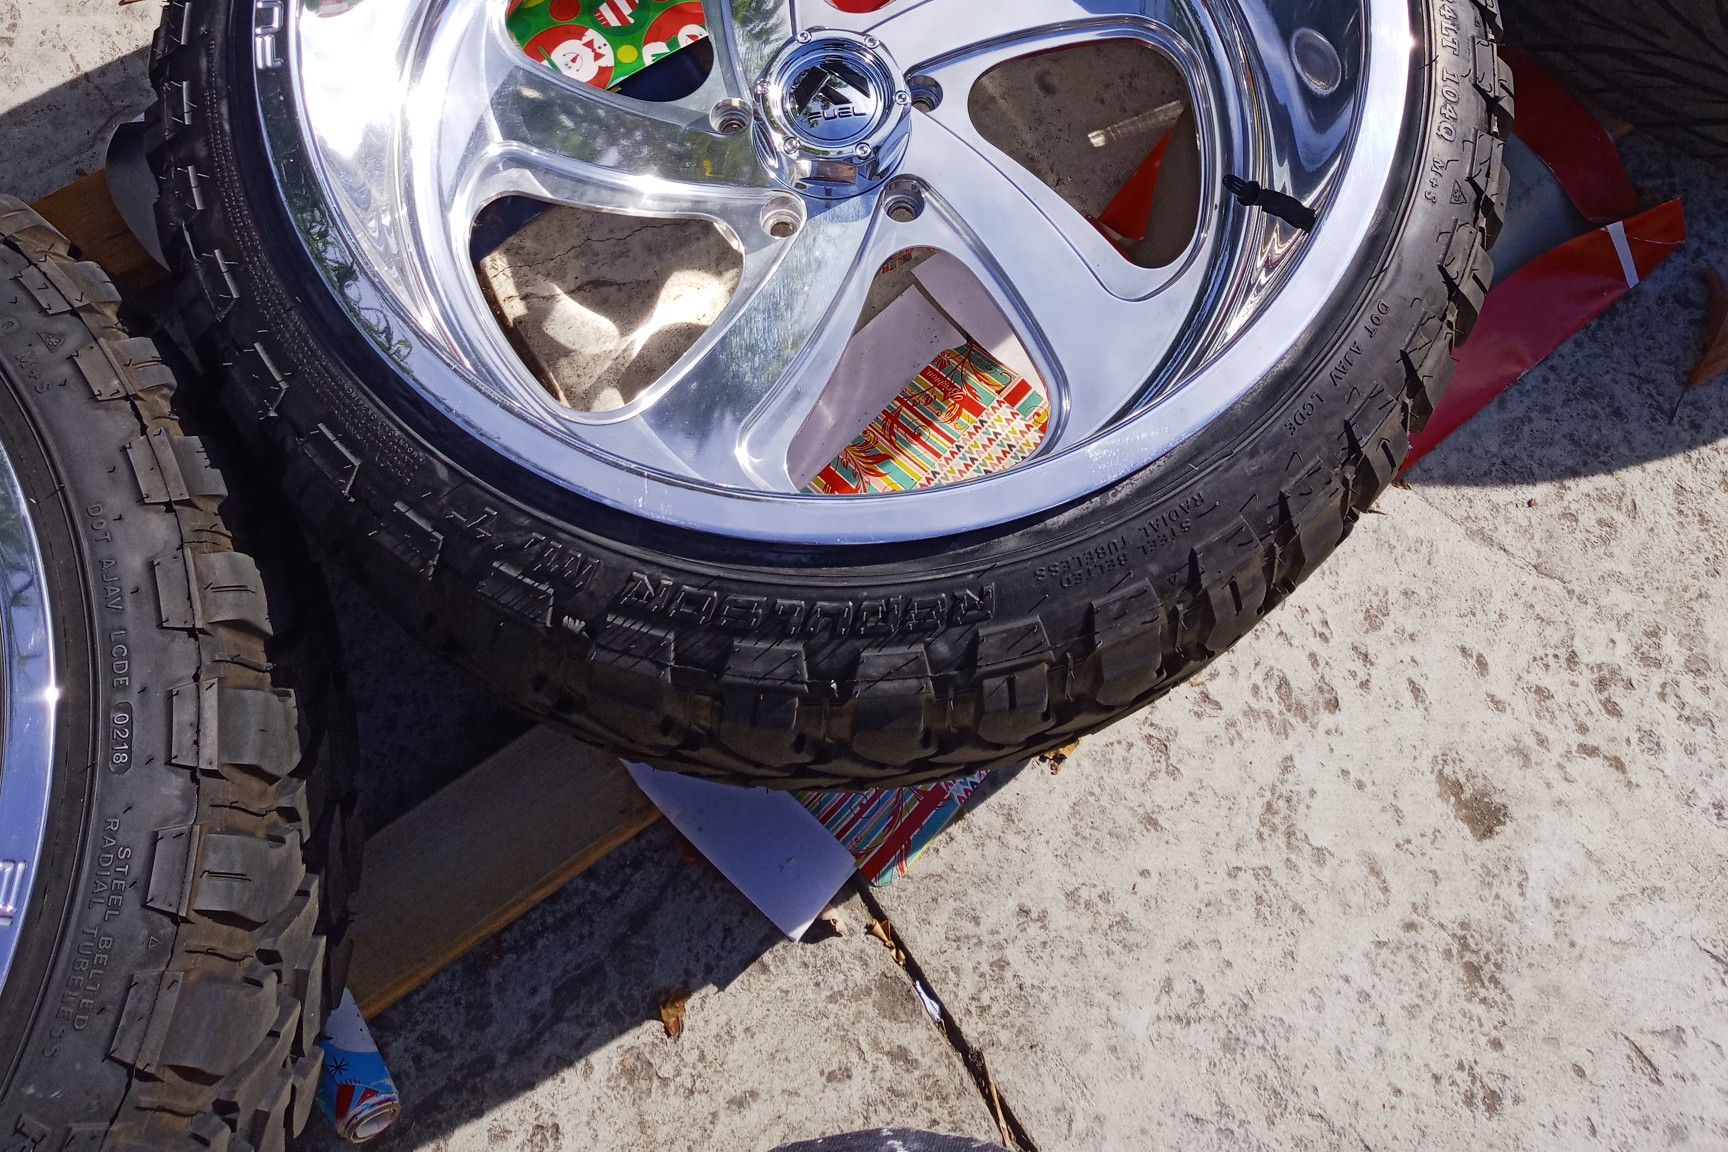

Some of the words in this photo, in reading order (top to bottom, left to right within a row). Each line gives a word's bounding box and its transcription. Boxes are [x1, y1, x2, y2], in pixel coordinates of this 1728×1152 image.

[807, 106, 867, 124] FUEL
[1436, 67, 1460, 144] 104Q
[1424, 158, 1446, 204] M+S
[1364, 299, 1391, 339] DOT
[1329, 340, 1363, 387] AJAV
[1284, 391, 1325, 436] LCDE
[87, 503, 112, 543] DOT
[1137, 518, 1193, 556] STEEL
[1138, 492, 1205, 538] RADIAL
[1033, 536, 1127, 581] TUBELESS
[1059, 553, 1128, 589] BELTED
[98, 559, 123, 612] AJAV
[109, 630, 129, 688] LCDE
[112, 712, 129, 764] 0218
[88, 817, 120, 910] RADIAL
[105, 846, 132, 922] STEEL
[42, 926, 100, 1059] TUBELESS
[73, 936, 114, 1031] BELTED
